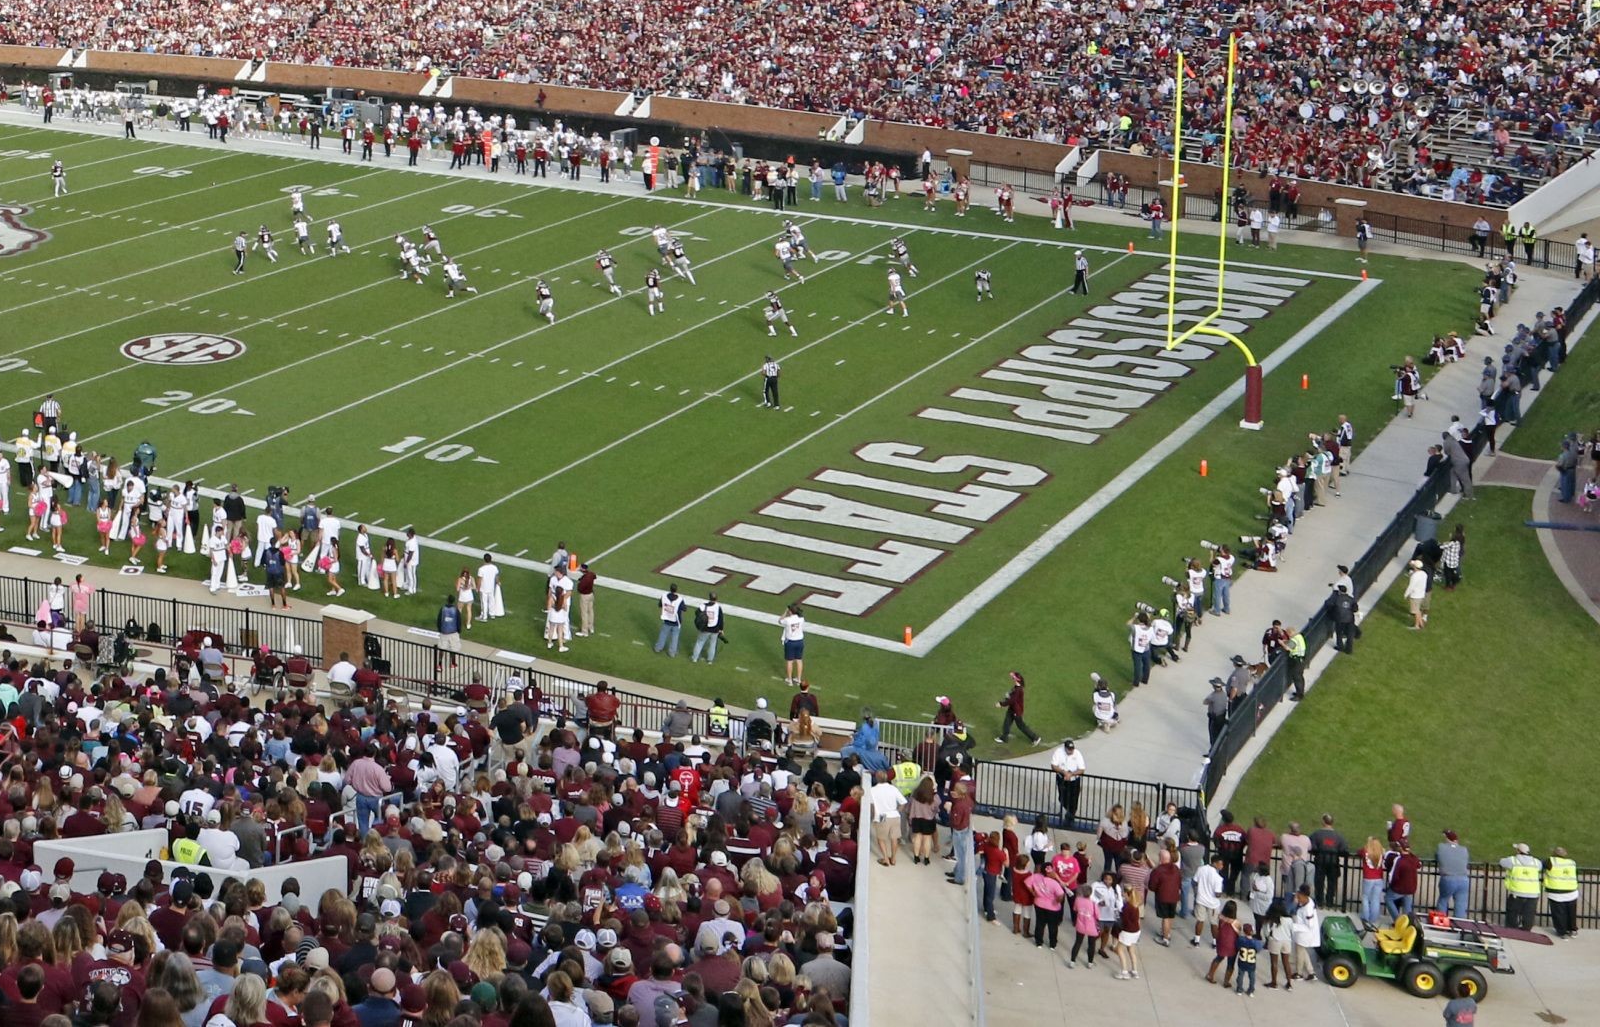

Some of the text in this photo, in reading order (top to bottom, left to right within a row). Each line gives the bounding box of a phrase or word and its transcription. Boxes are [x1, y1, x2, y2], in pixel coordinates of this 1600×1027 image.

[128, 334, 236, 363] SEC
[141, 390, 237, 415] 20
[380, 436, 475, 462] 10
[653, 262, 1314, 618] MISSISSIPPI STATE
[185, 800, 204, 817] 15
[179, 846, 193, 856] POLICE
[1239, 947, 1257, 964] 32
